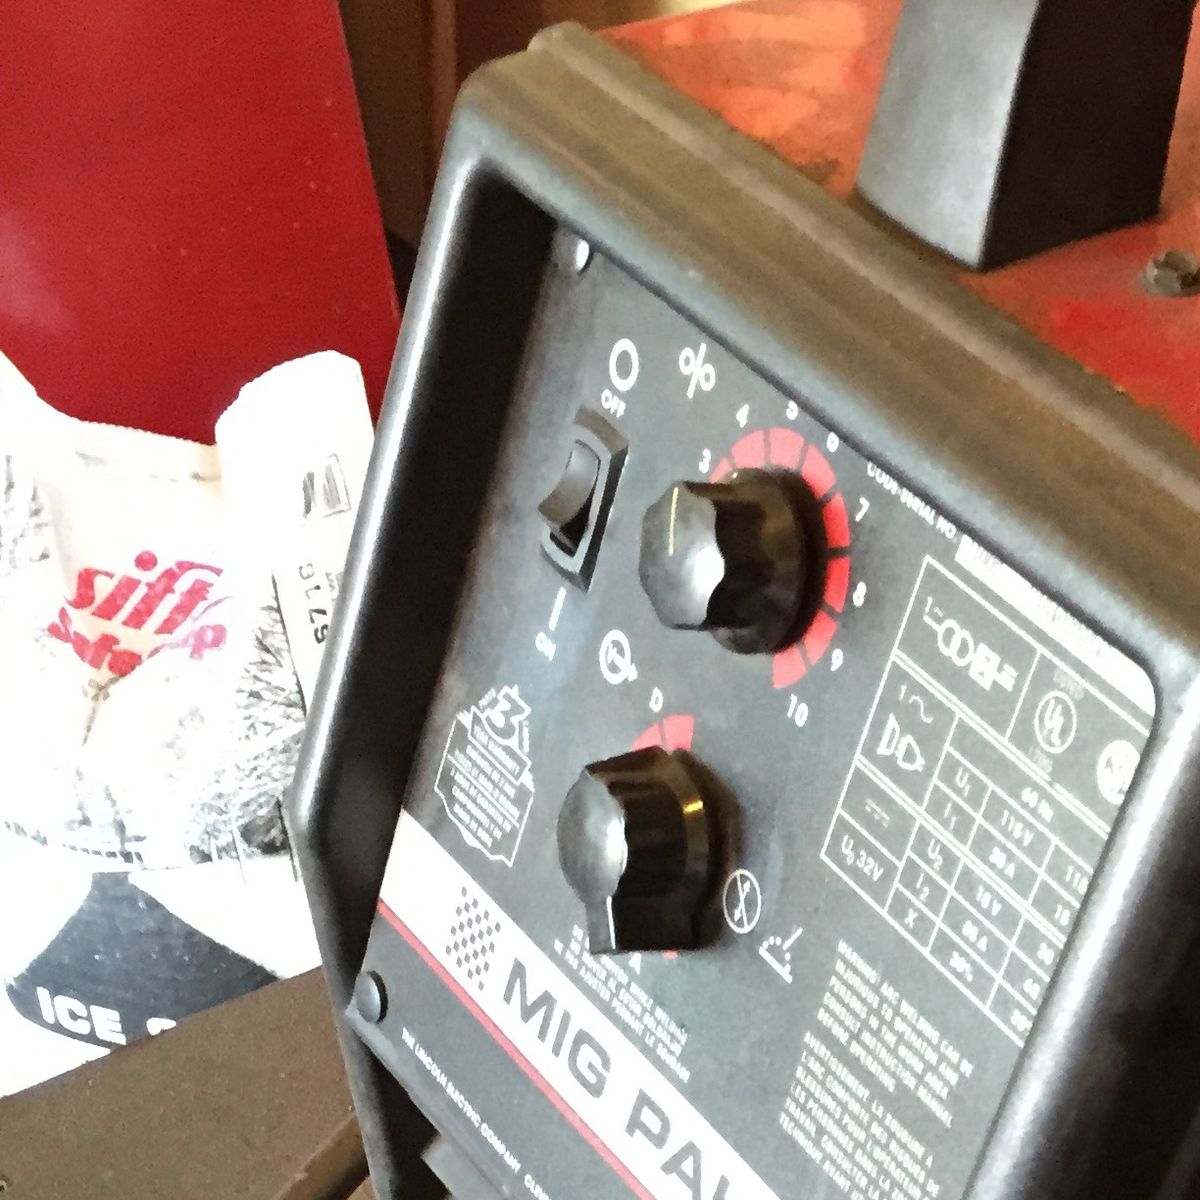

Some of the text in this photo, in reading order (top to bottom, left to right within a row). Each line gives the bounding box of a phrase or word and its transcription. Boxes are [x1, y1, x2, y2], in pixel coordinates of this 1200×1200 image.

[736, 404, 751, 428] 4
[698, 448, 712, 475] 3
[855, 496, 870, 522] 7
[852, 580, 867, 608] 8
[786, 693, 810, 728] 10
[36, 986, 127, 1045] ICE
[503, 959, 613, 1098] MIG
